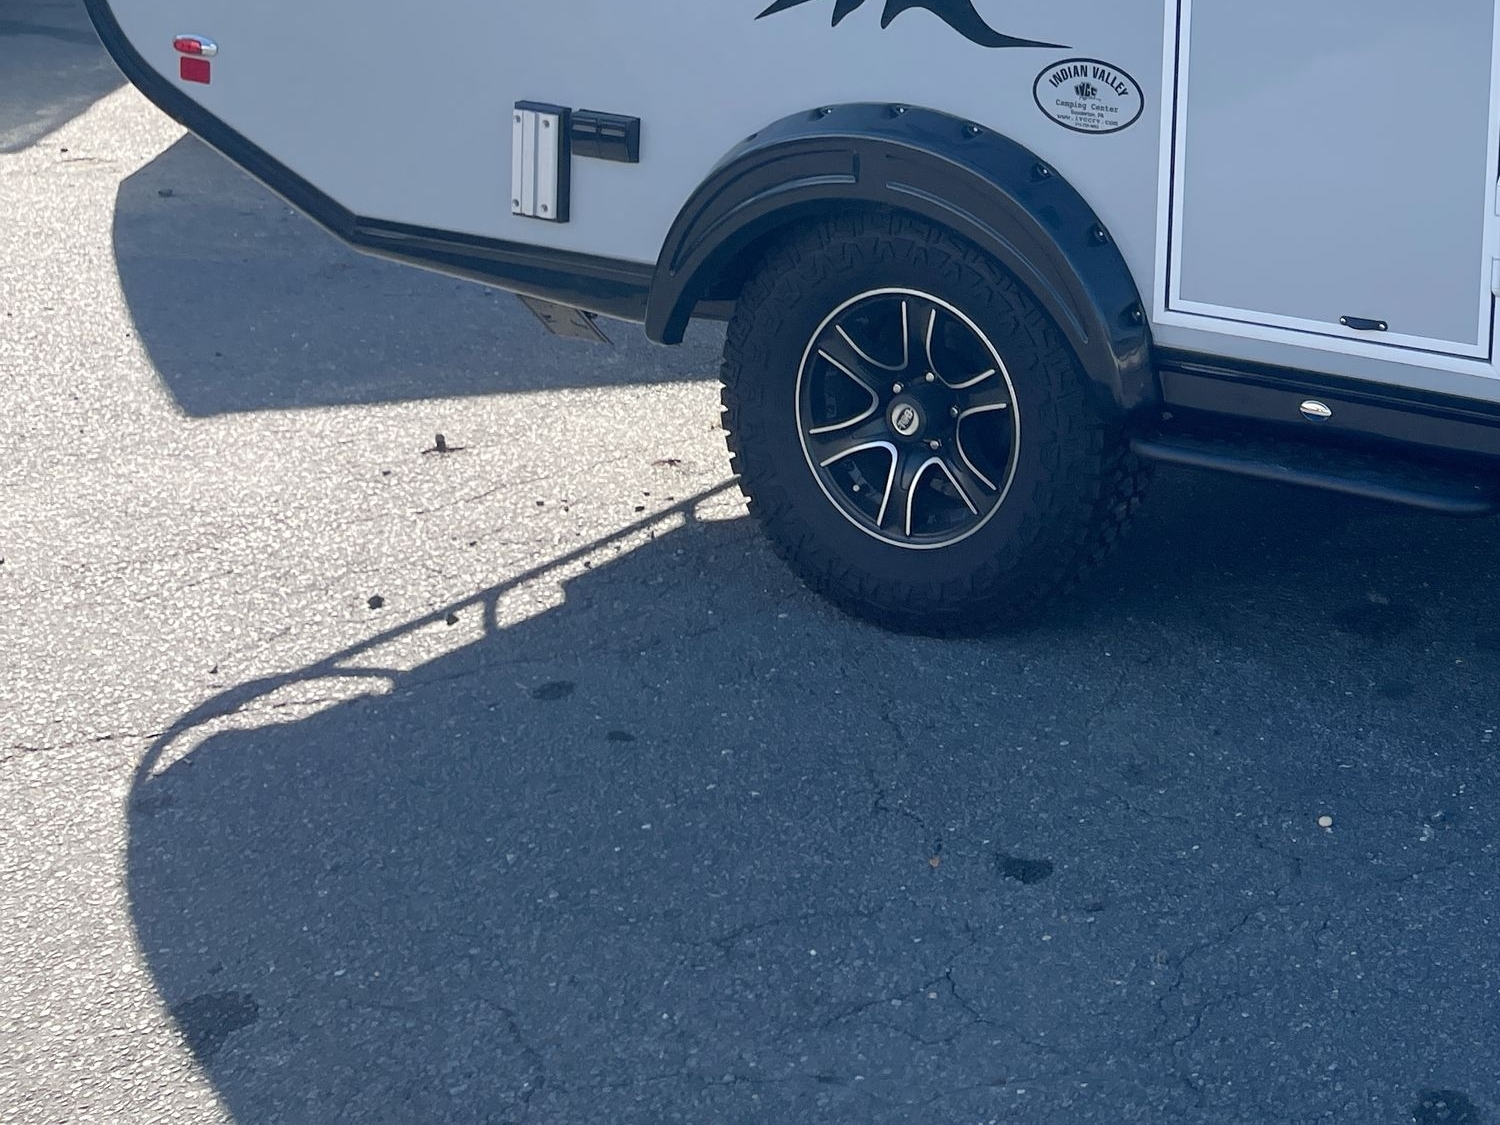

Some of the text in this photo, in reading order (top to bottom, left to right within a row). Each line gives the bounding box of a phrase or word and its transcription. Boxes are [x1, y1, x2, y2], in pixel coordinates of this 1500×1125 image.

[1049, 64, 1129, 97] INDIAN VALLEY
[1056, 99, 1087, 111] Camping
[1091, 103, 1119, 113] Center
